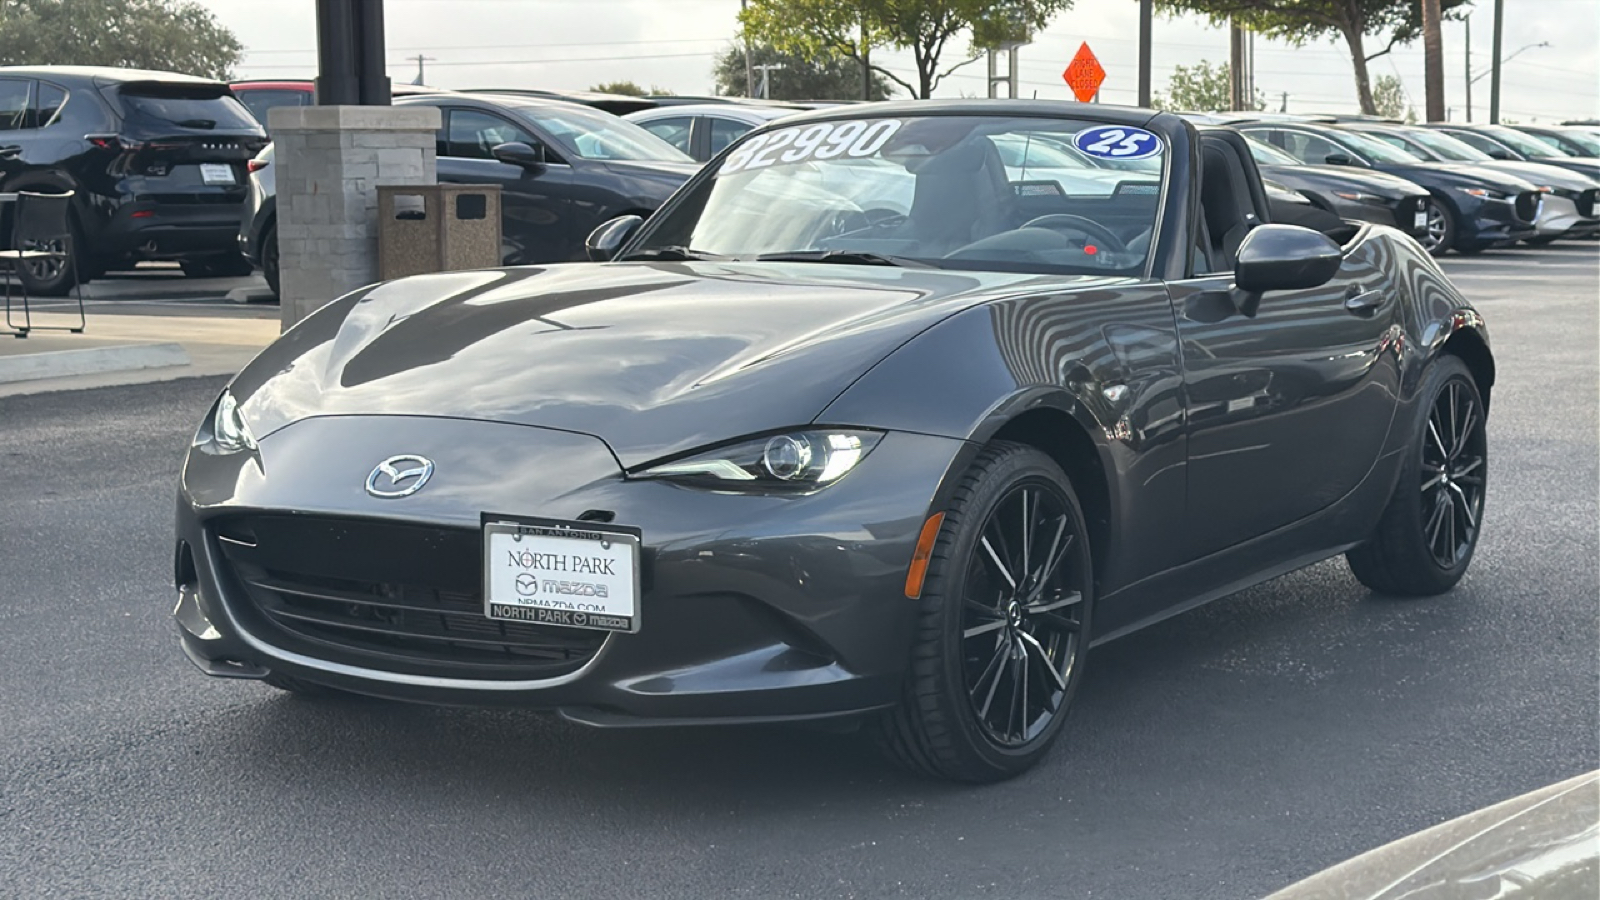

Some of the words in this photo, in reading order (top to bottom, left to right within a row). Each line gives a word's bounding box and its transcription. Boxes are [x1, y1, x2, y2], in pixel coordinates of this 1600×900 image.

[1075, 68, 1093, 78] LANE
[1071, 79, 1098, 89] CLOSED
[1086, 129, 1151, 156] 25
[520, 528, 544, 536] SAN
[549, 529, 601, 540] ANTONIO
[508, 549, 567, 571] NORTH
[573, 555, 616, 575] PARK
[518, 597, 606, 613] NPMAZDACOM
[493, 605, 535, 620] NORTH
[538, 609, 571, 624] PARK
[589, 615, 629, 628] mazda
